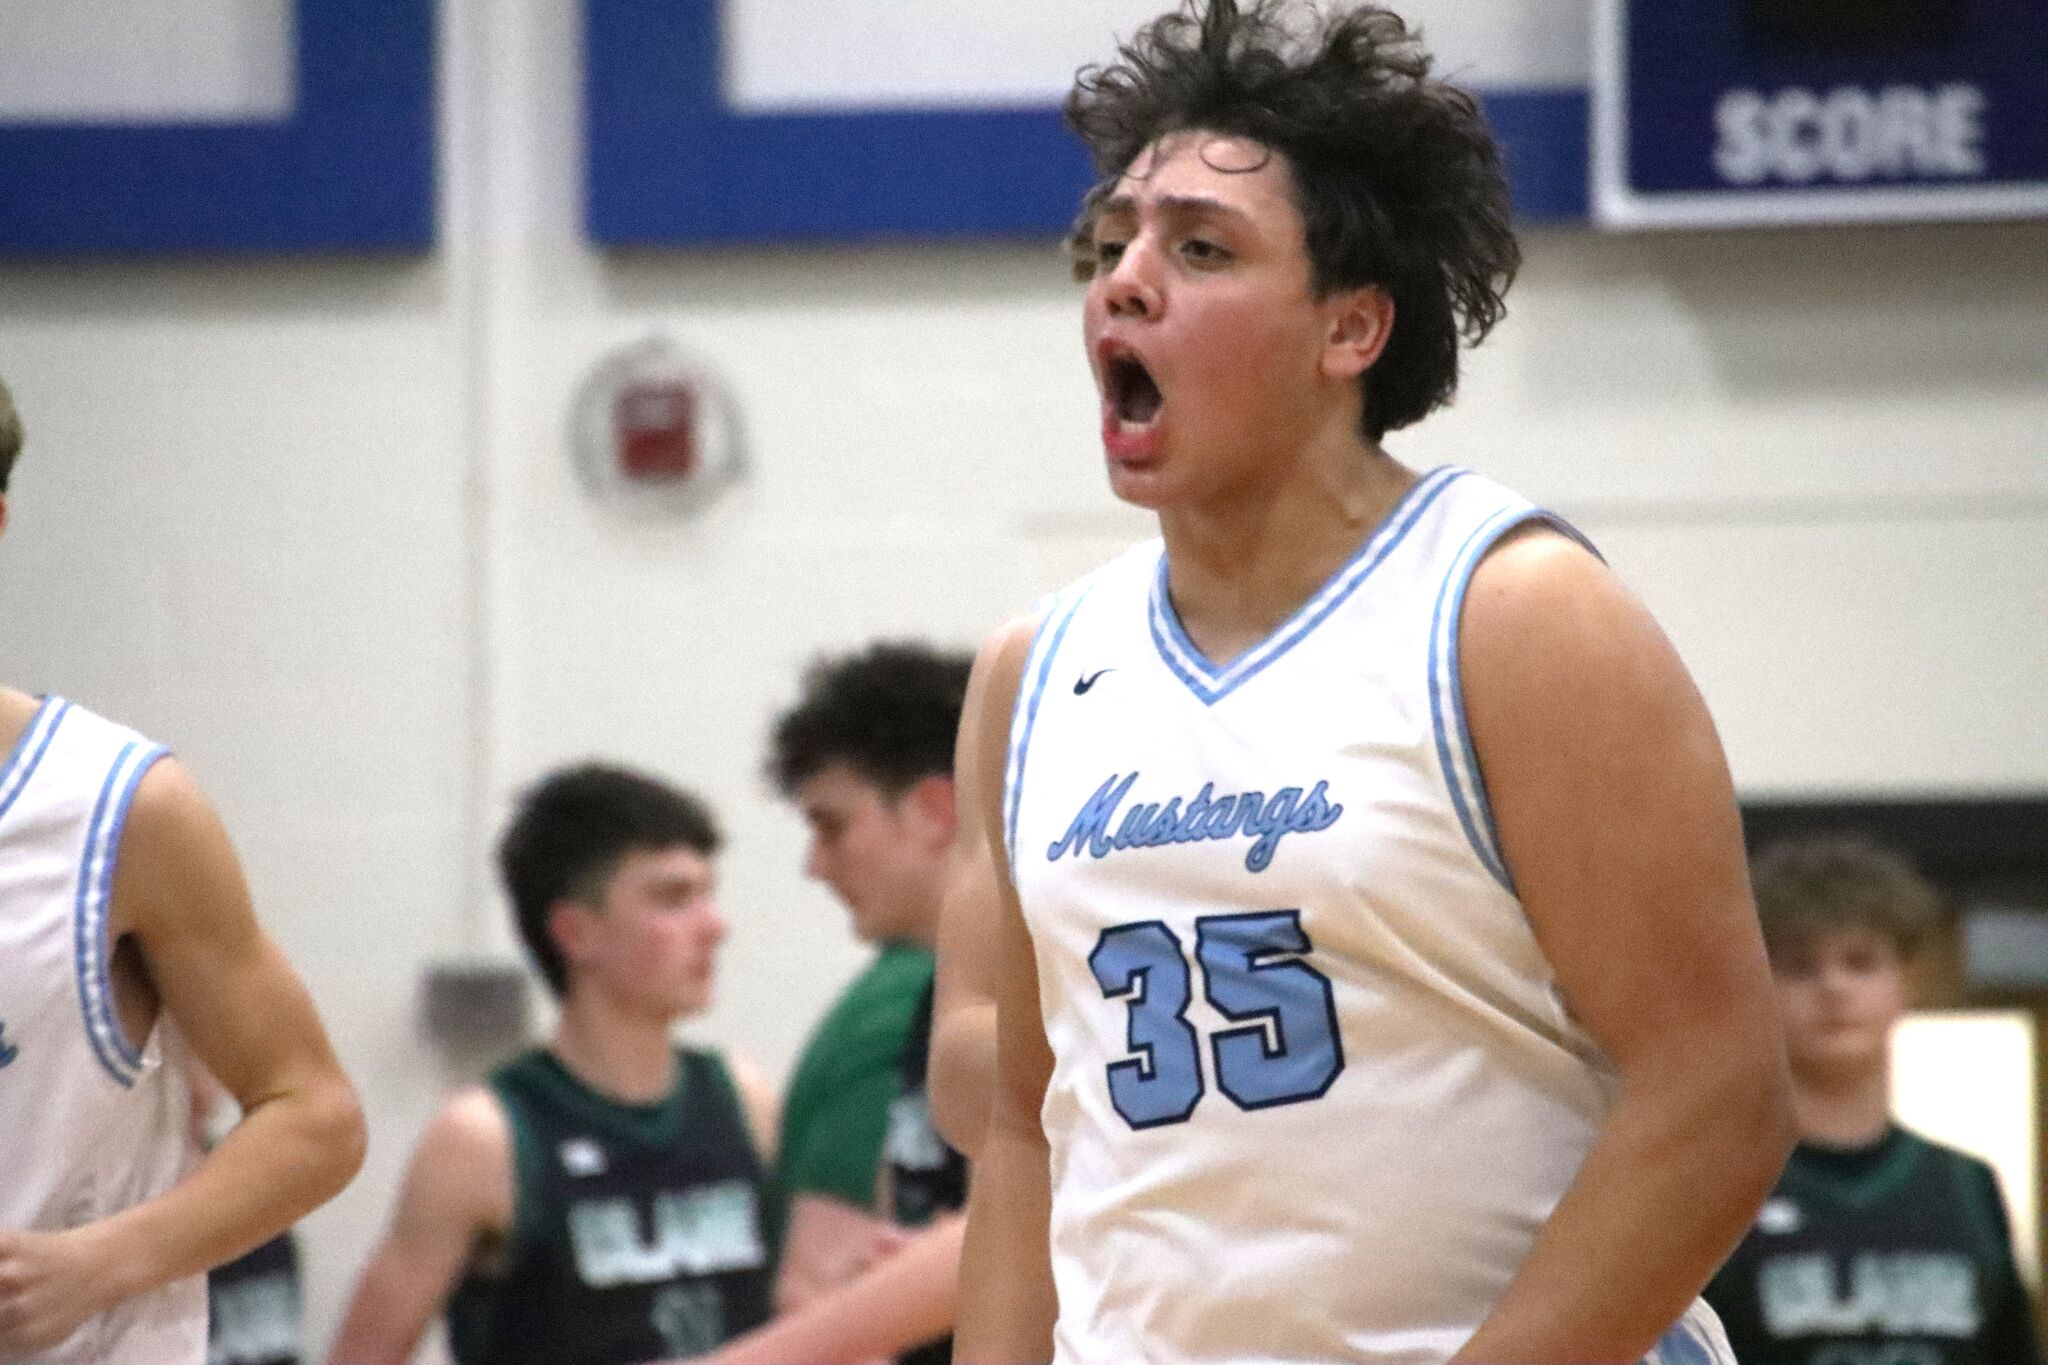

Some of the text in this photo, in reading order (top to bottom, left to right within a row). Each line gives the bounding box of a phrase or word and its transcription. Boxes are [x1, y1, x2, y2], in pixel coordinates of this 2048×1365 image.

[1714, 83, 1986, 182] SCORE
[1046, 771, 1344, 873] Mustangs
[1088, 909, 1346, 1131] 35
